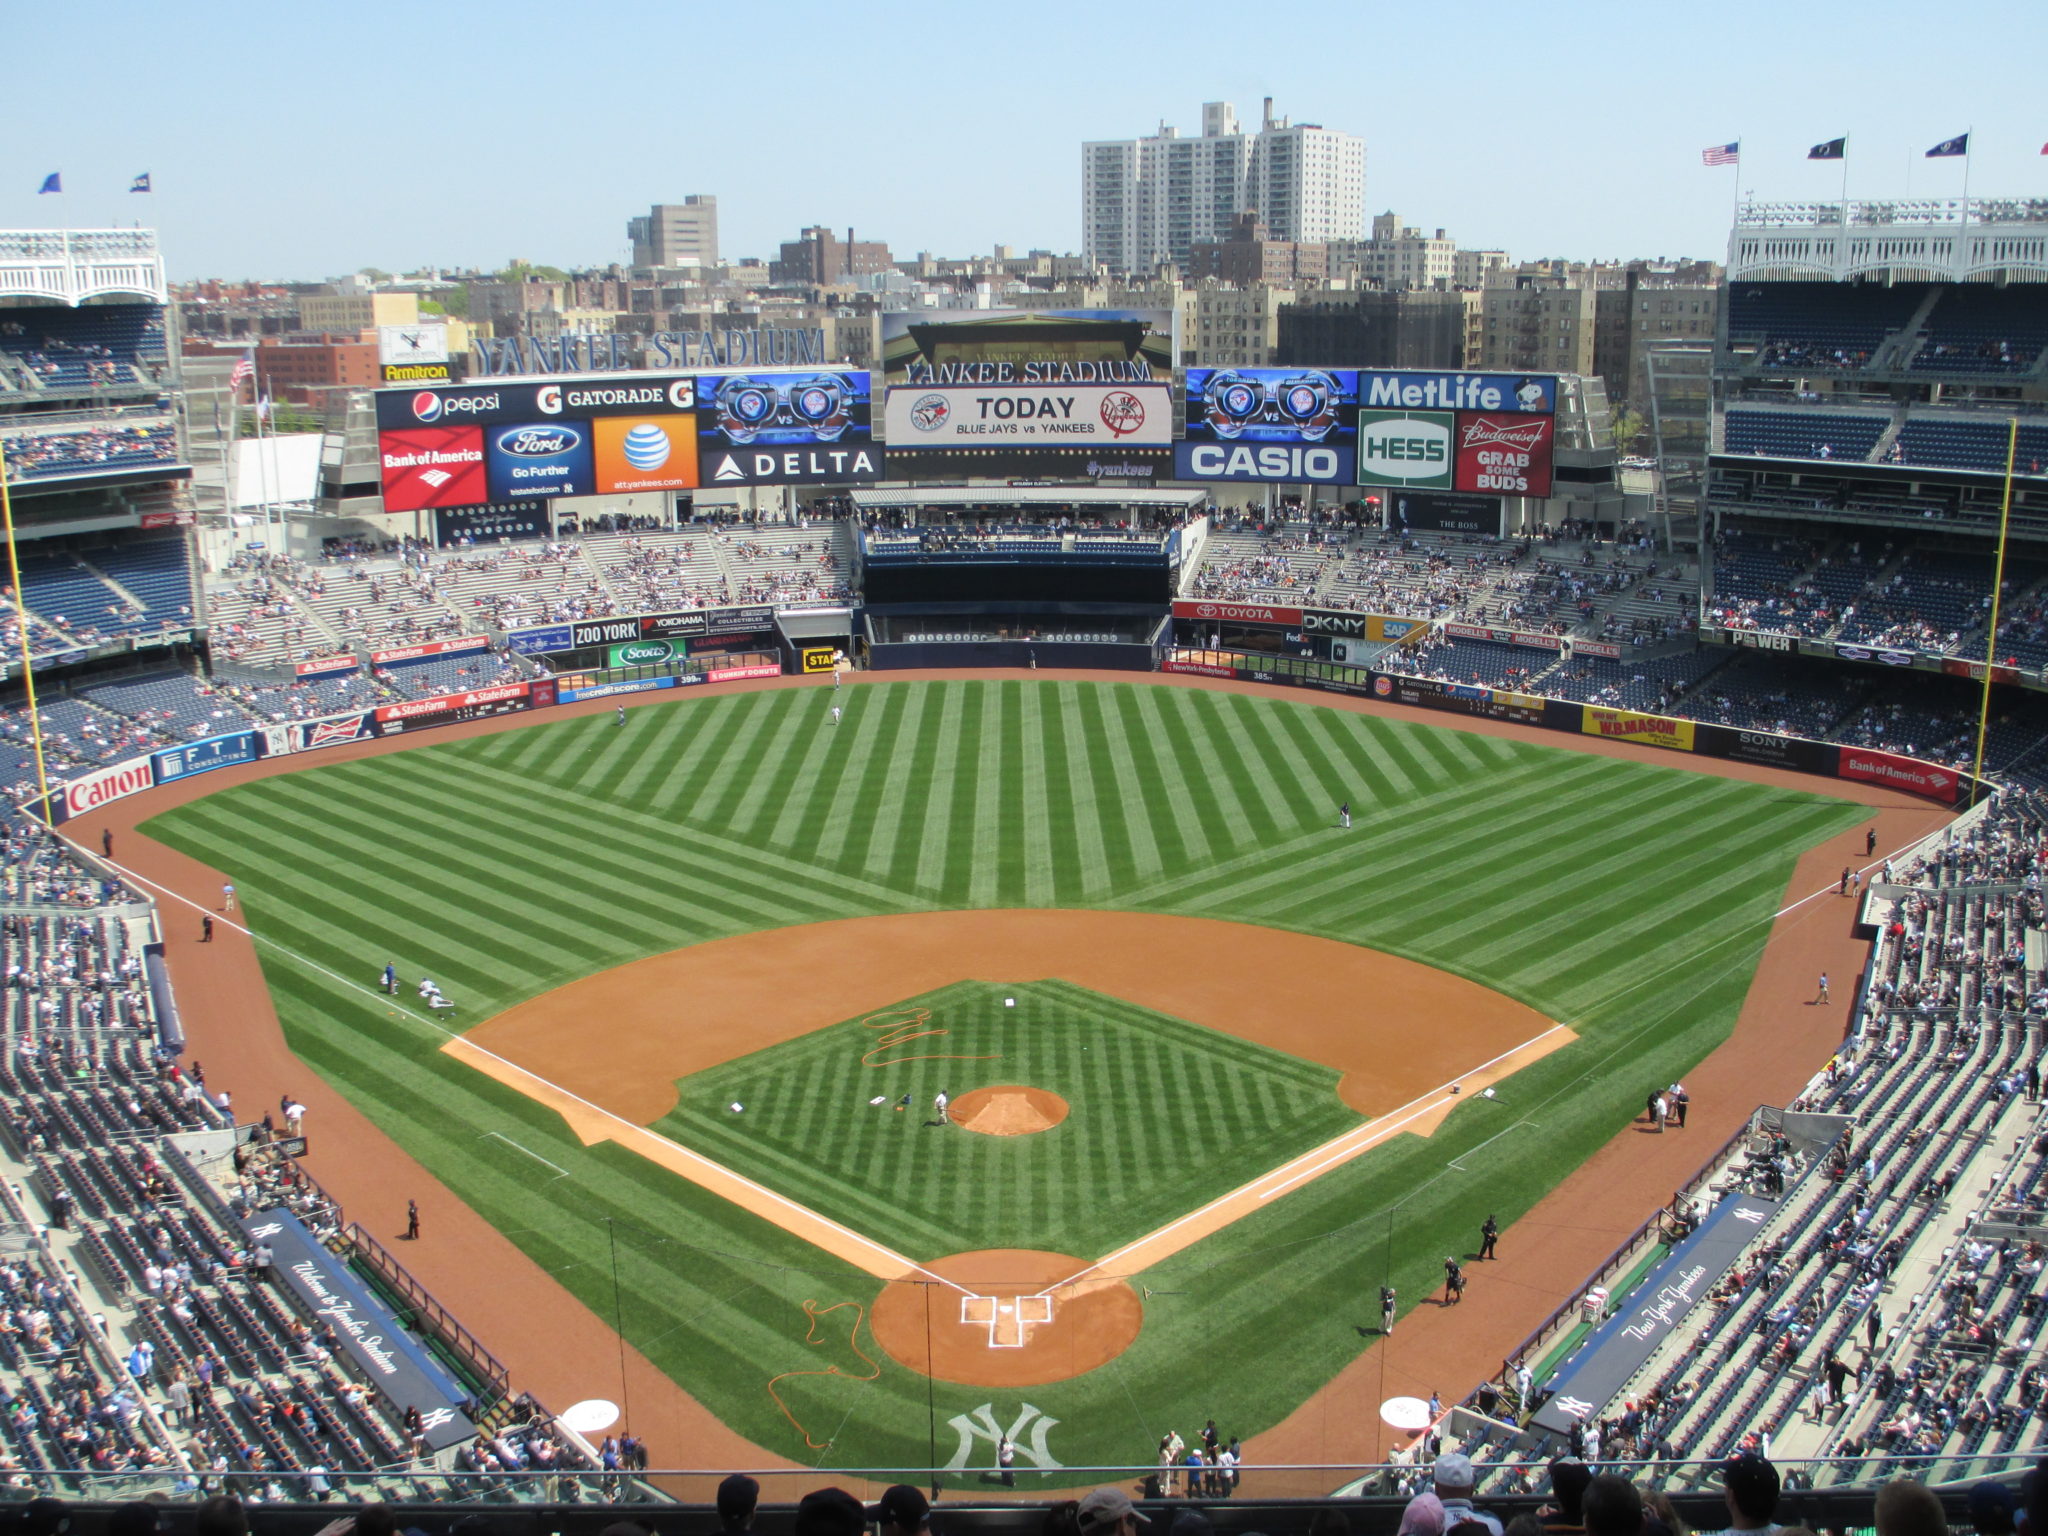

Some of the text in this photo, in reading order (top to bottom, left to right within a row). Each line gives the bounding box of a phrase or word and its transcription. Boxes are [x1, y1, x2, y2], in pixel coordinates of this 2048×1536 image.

[472, 329, 828, 377] YANKEE STADIUM
[385, 364, 449, 381] Armitron
[905, 361, 1153, 385] YANKEE STADIUM
[537, 380, 694, 414] G GATORADE G
[1369, 375, 1501, 410] MetLife
[444, 393, 500, 416] pepsi
[976, 397, 1075, 419] TODAY
[956, 424, 987, 434] BLUE
[989, 424, 1018, 434] JAYS
[1042, 423, 1095, 433] YANKEES
[1462, 425, 1543, 442] Budweiser
[513, 430, 564, 453] Ford
[1368, 437, 1445, 462] HESS
[384, 449, 483, 468] Bank of America
[755, 452, 874, 476] DELTA
[1191, 445, 1338, 478] CASIO
[1477, 451, 1530, 467] GRAB
[513, 465, 570, 478] Go Further
[1087, 461, 1154, 479] #yankees
[1486, 466, 1521, 476] SOME
[510, 486, 560, 496] tristateford.com
[614, 479, 683, 490] att.yankees.com
[1477, 474, 1528, 491] BUDS
[1440, 520, 1479, 530] THE BOSS
[656, 615, 705, 627] YOKOHAMA
[1219, 606, 1273, 620] TOYOTA
[1303, 614, 1365, 634] DKNY
[1383, 623, 1408, 637] SAP
[1448, 626, 1488, 638] MODELL'S
[576, 627, 601, 645] ZOO
[602, 622, 637, 641] YORK
[1286, 632, 1309, 643] FedEx
[1515, 634, 1556, 648] MODELL'S
[1733, 631, 1790, 651] PWER
[626, 646, 666, 660] Scotts
[1575, 643, 1619, 656] MODELL'S
[747, 667, 778, 675] DONUTS
[575, 682, 657, 700] freecreditscore.com
[1406, 680, 1434, 690] GATORADE
[1740, 732, 1791, 749] SONY
[1849, 759, 1926, 785] Bank of America
[69, 763, 151, 812] Canon
[1621, 1264, 1706, 1342] New York Yankees
[291, 1260, 398, 1375] Welcome to Yankee Stadium
